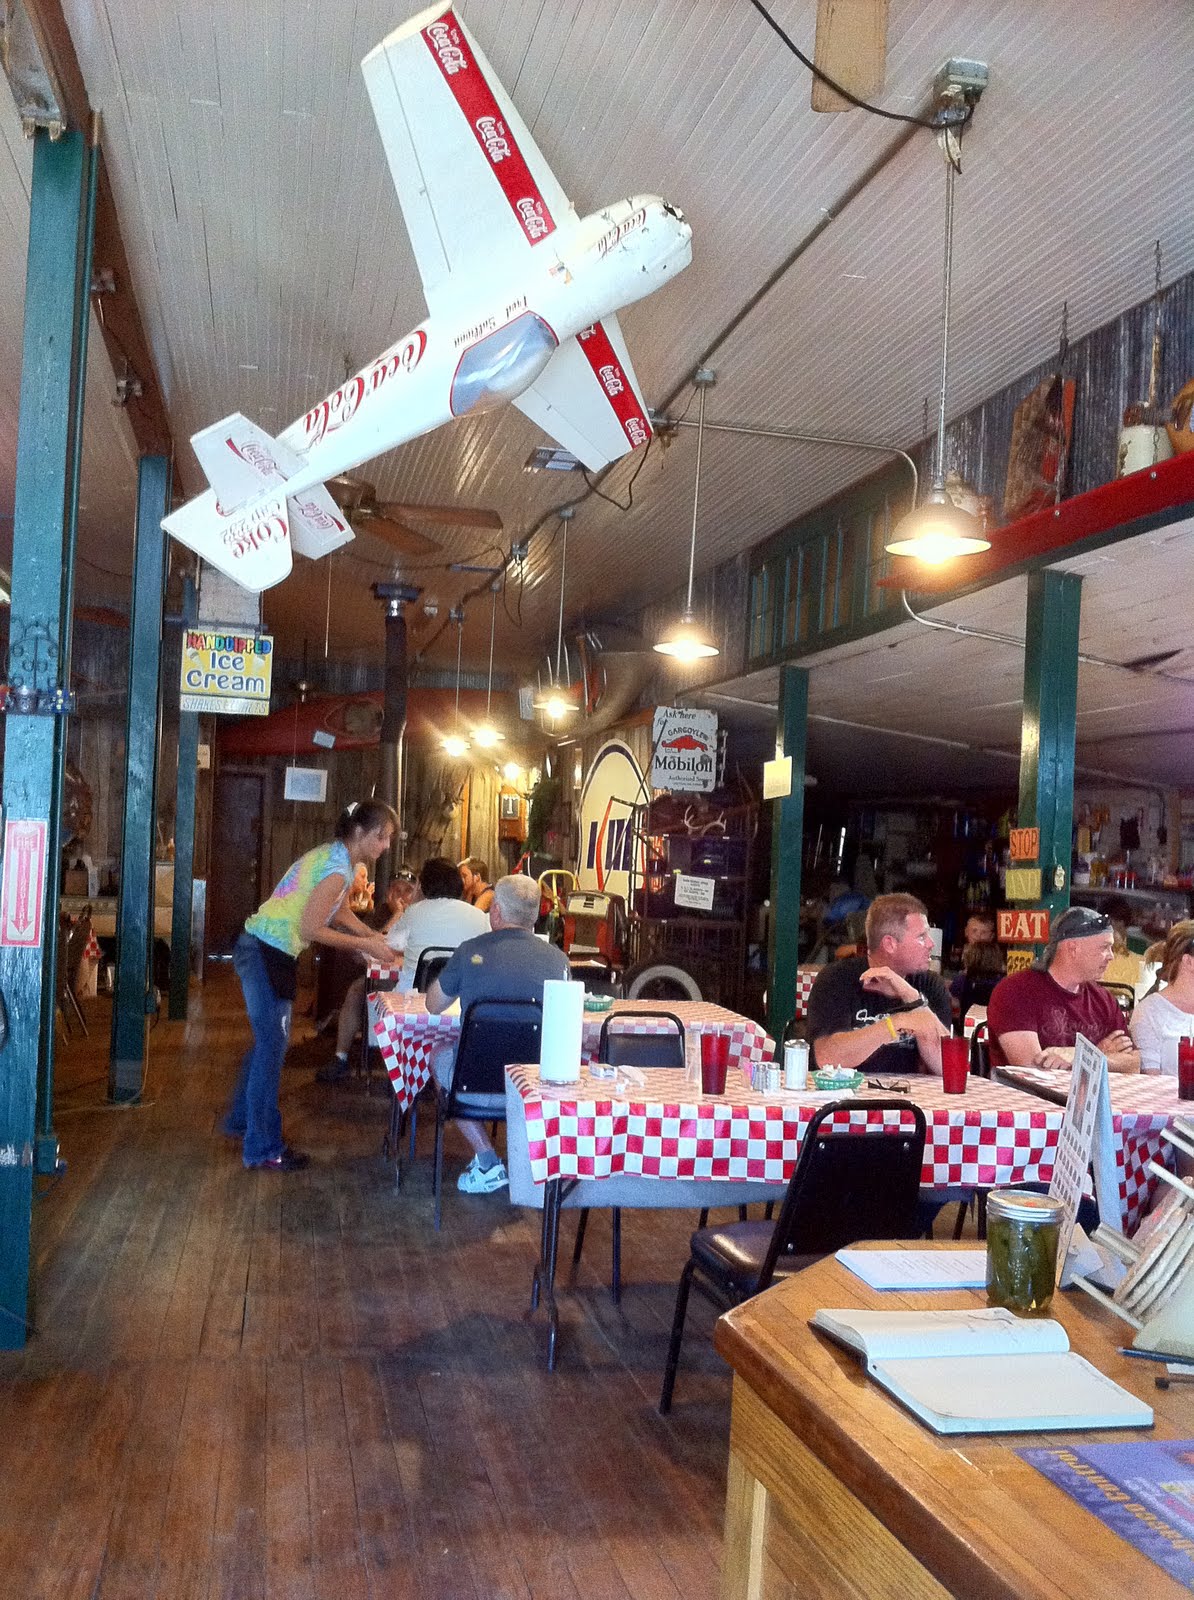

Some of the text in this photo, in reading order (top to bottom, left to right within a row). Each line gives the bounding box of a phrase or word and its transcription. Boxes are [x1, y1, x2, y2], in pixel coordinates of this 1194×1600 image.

[210, 652, 245, 671] Ice
[186, 669, 265, 693] Cream
[663, 709, 697, 720] Ask here
[654, 755, 713, 773] Mobiloil
[1010, 829, 1038, 858] STOP
[999, 912, 1047, 940] EAT
